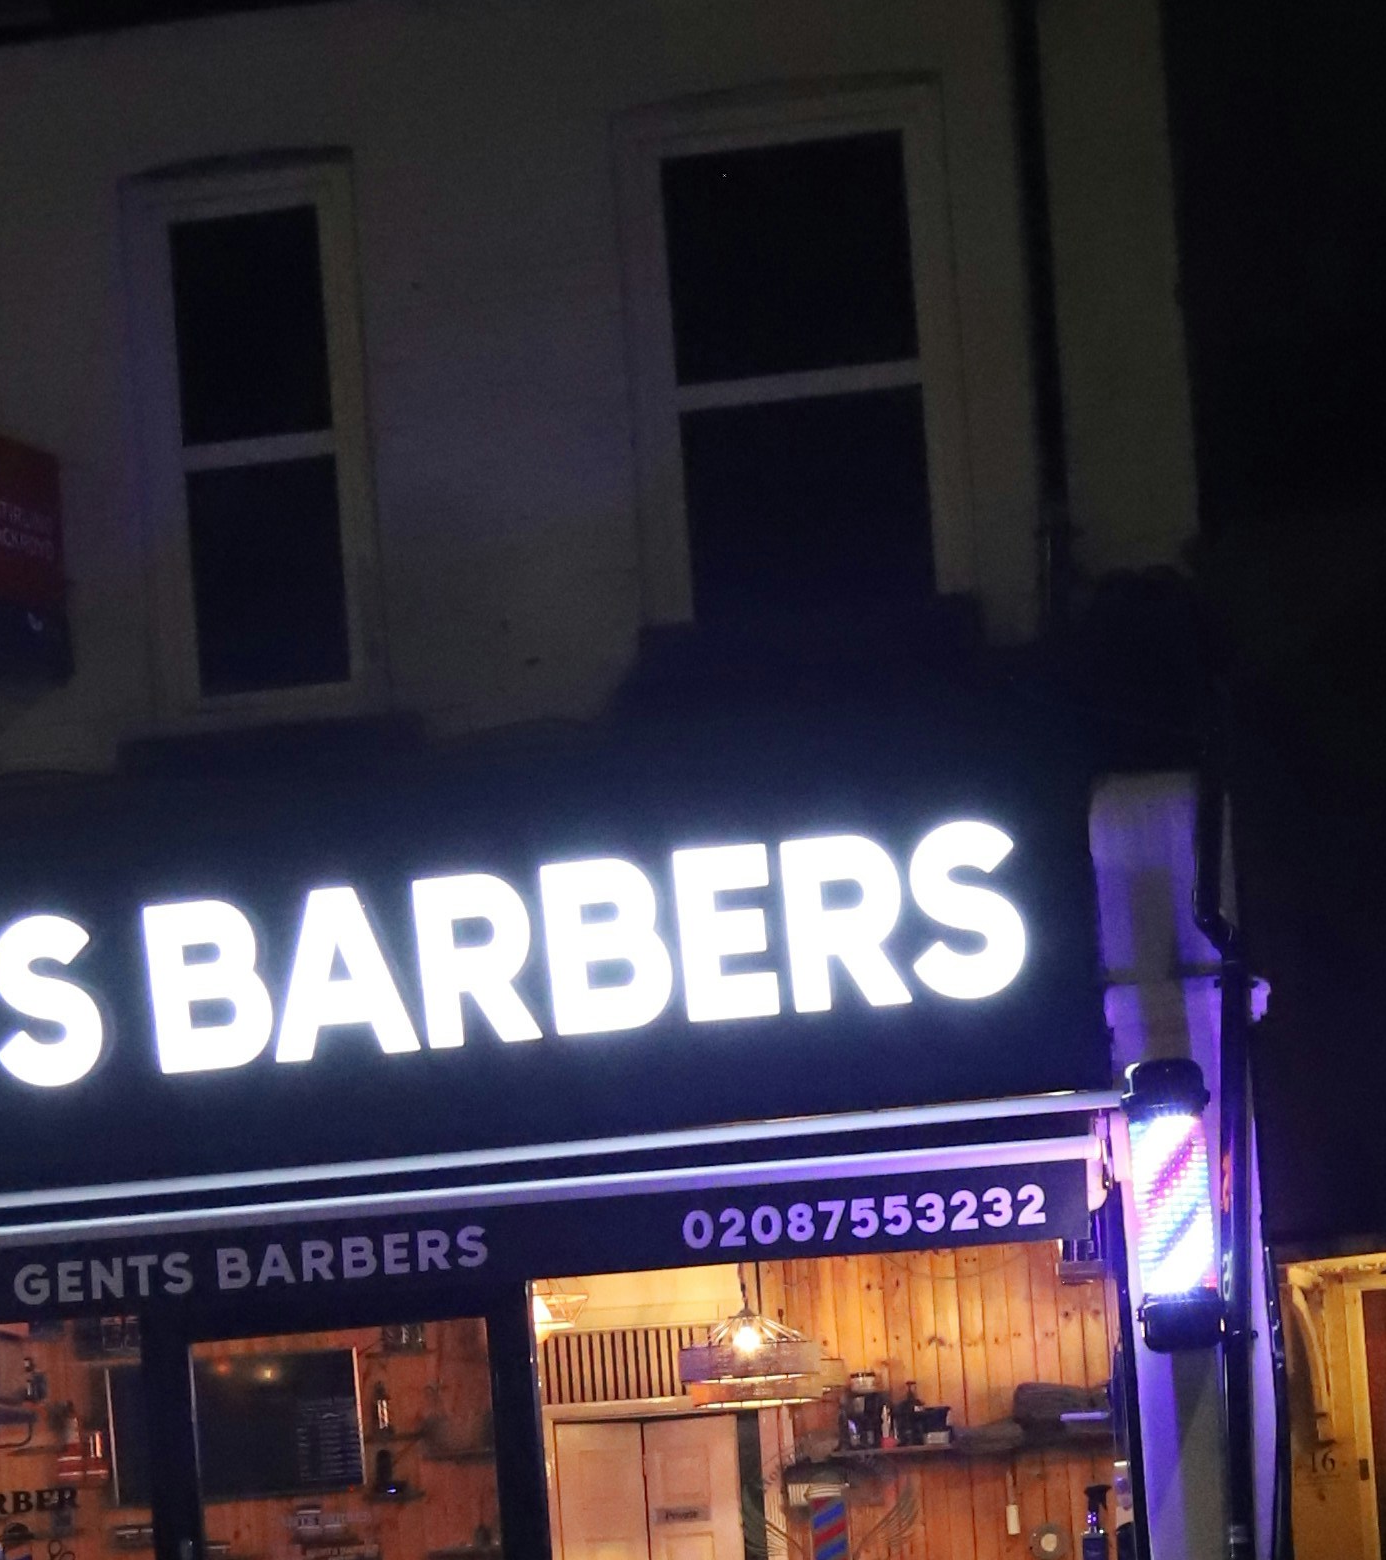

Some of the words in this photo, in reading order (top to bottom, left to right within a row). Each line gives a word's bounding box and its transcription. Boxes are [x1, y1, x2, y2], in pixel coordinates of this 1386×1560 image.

[143, 819, 1027, 1075] BARBERS
[682, 1183, 1047, 1250] 02087553232
[13, 1252, 194, 1306] GENTS
[215, 1225, 489, 1290] BARBERS
[1310, 1448, 1336, 1474] 16
